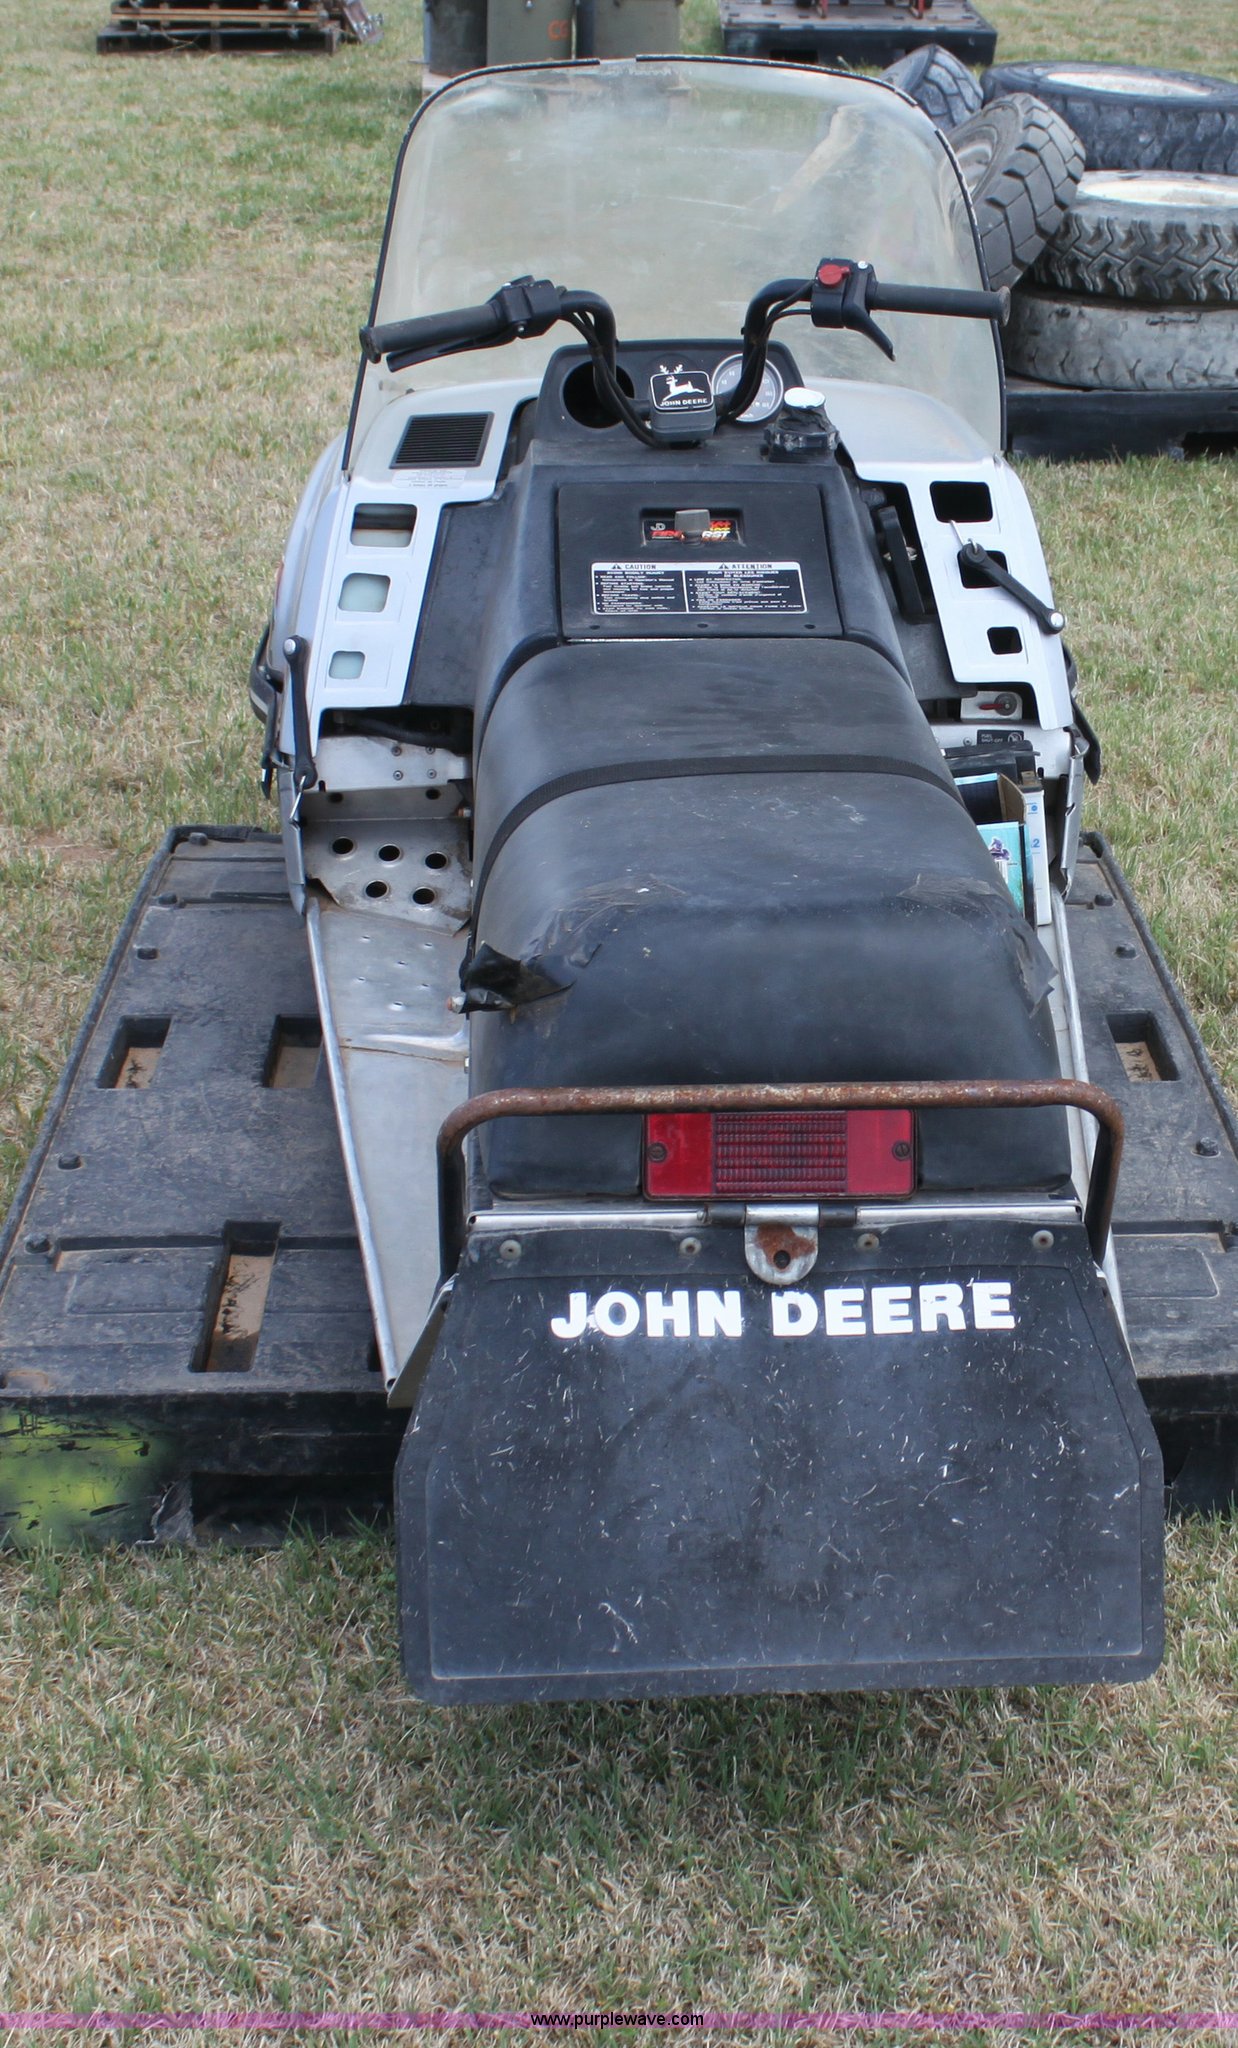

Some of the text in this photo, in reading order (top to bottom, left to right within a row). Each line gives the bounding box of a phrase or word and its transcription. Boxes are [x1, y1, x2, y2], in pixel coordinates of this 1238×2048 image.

[682, 398, 708, 406] DEERE
[650, 523, 666, 531] JD
[550, 1281, 1016, 1339] JOHN DEERE
